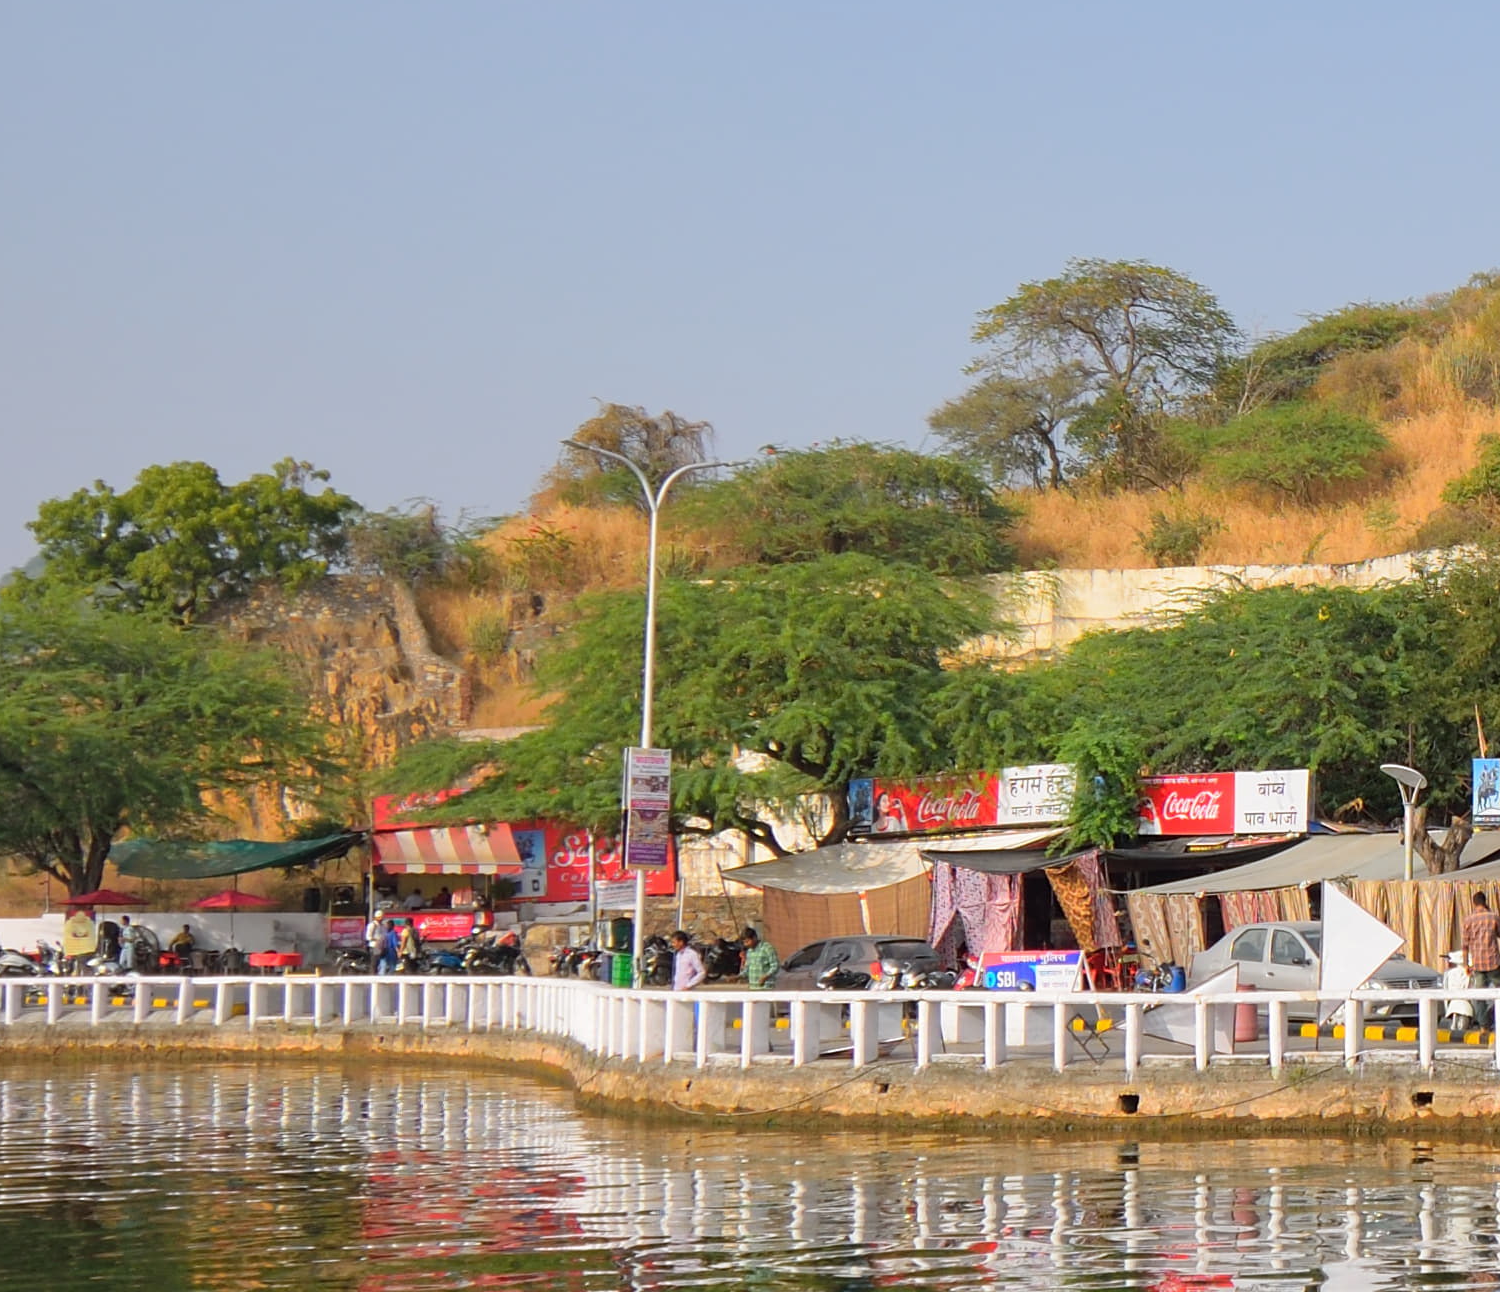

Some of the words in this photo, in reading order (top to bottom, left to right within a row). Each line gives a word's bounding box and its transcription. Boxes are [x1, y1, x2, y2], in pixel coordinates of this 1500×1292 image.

[1257, 777, 1286, 797] बोम्बे
[917, 790, 981, 823] Coca-Cola
[1163, 790, 1222, 820] Coca-Cola
[1244, 811, 1265, 826] पाव
[1269, 805, 1298, 826] भाजी
[997, 971, 1016, 988] SBI
